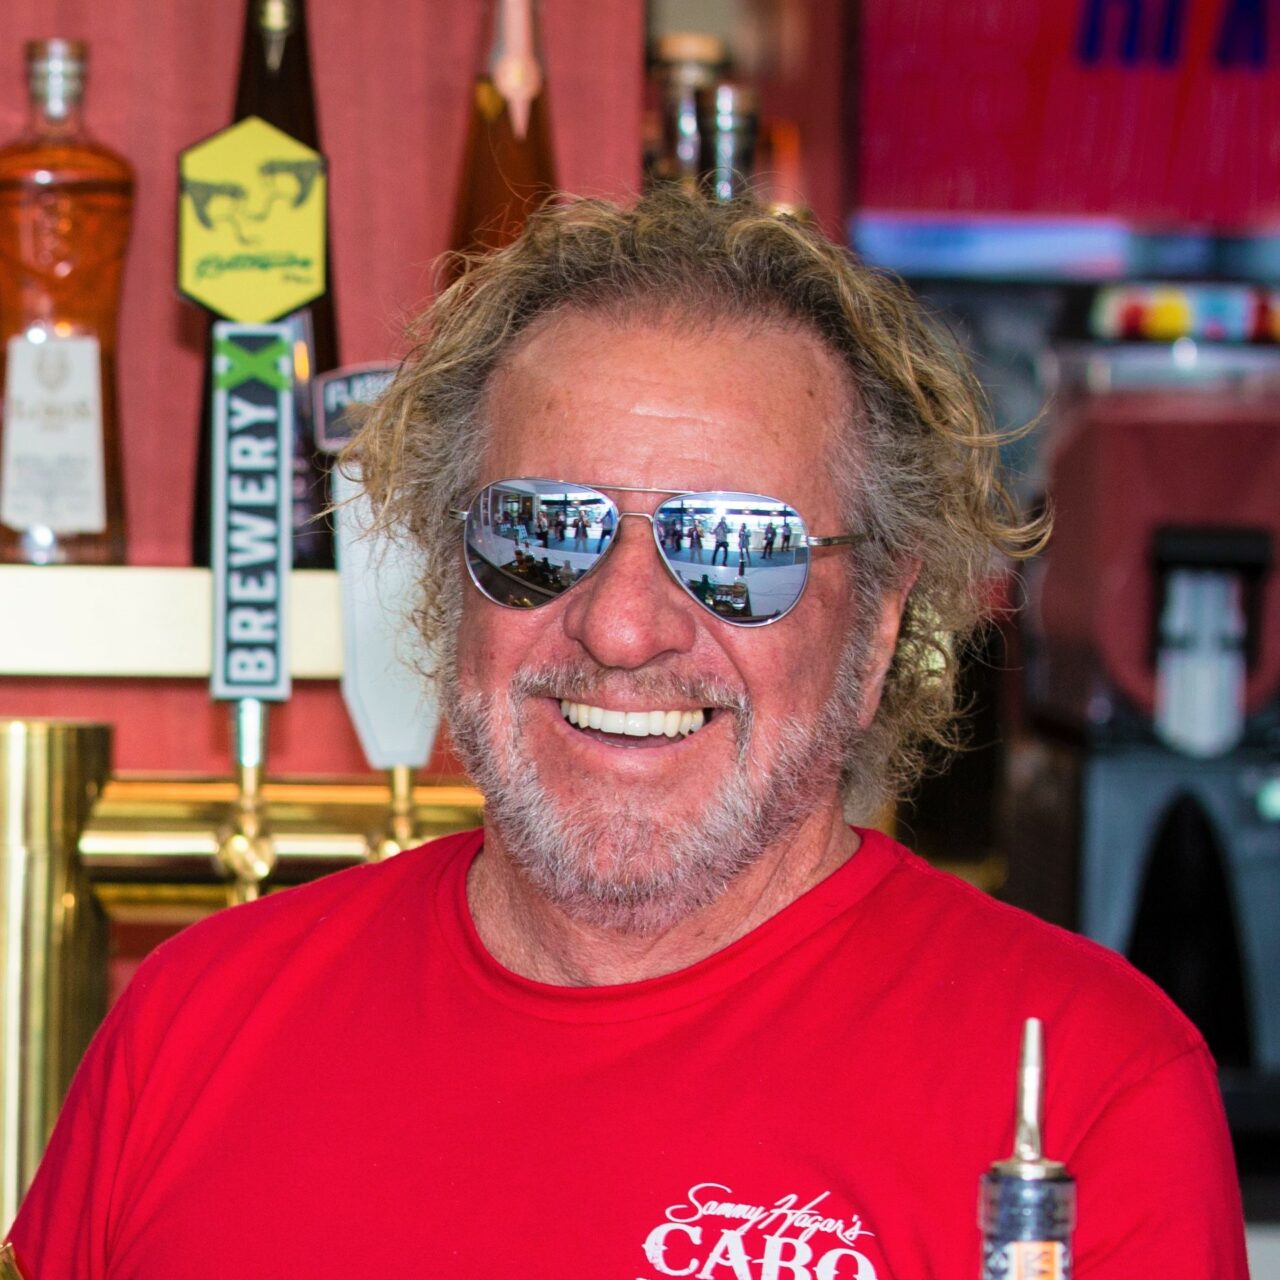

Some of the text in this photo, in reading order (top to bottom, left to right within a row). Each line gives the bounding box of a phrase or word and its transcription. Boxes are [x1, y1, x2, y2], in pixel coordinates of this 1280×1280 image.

[215, 339, 290, 391] X
[229, 396, 278, 683] BREWERY
[665, 1182, 875, 1247] Sammy Hagar's
